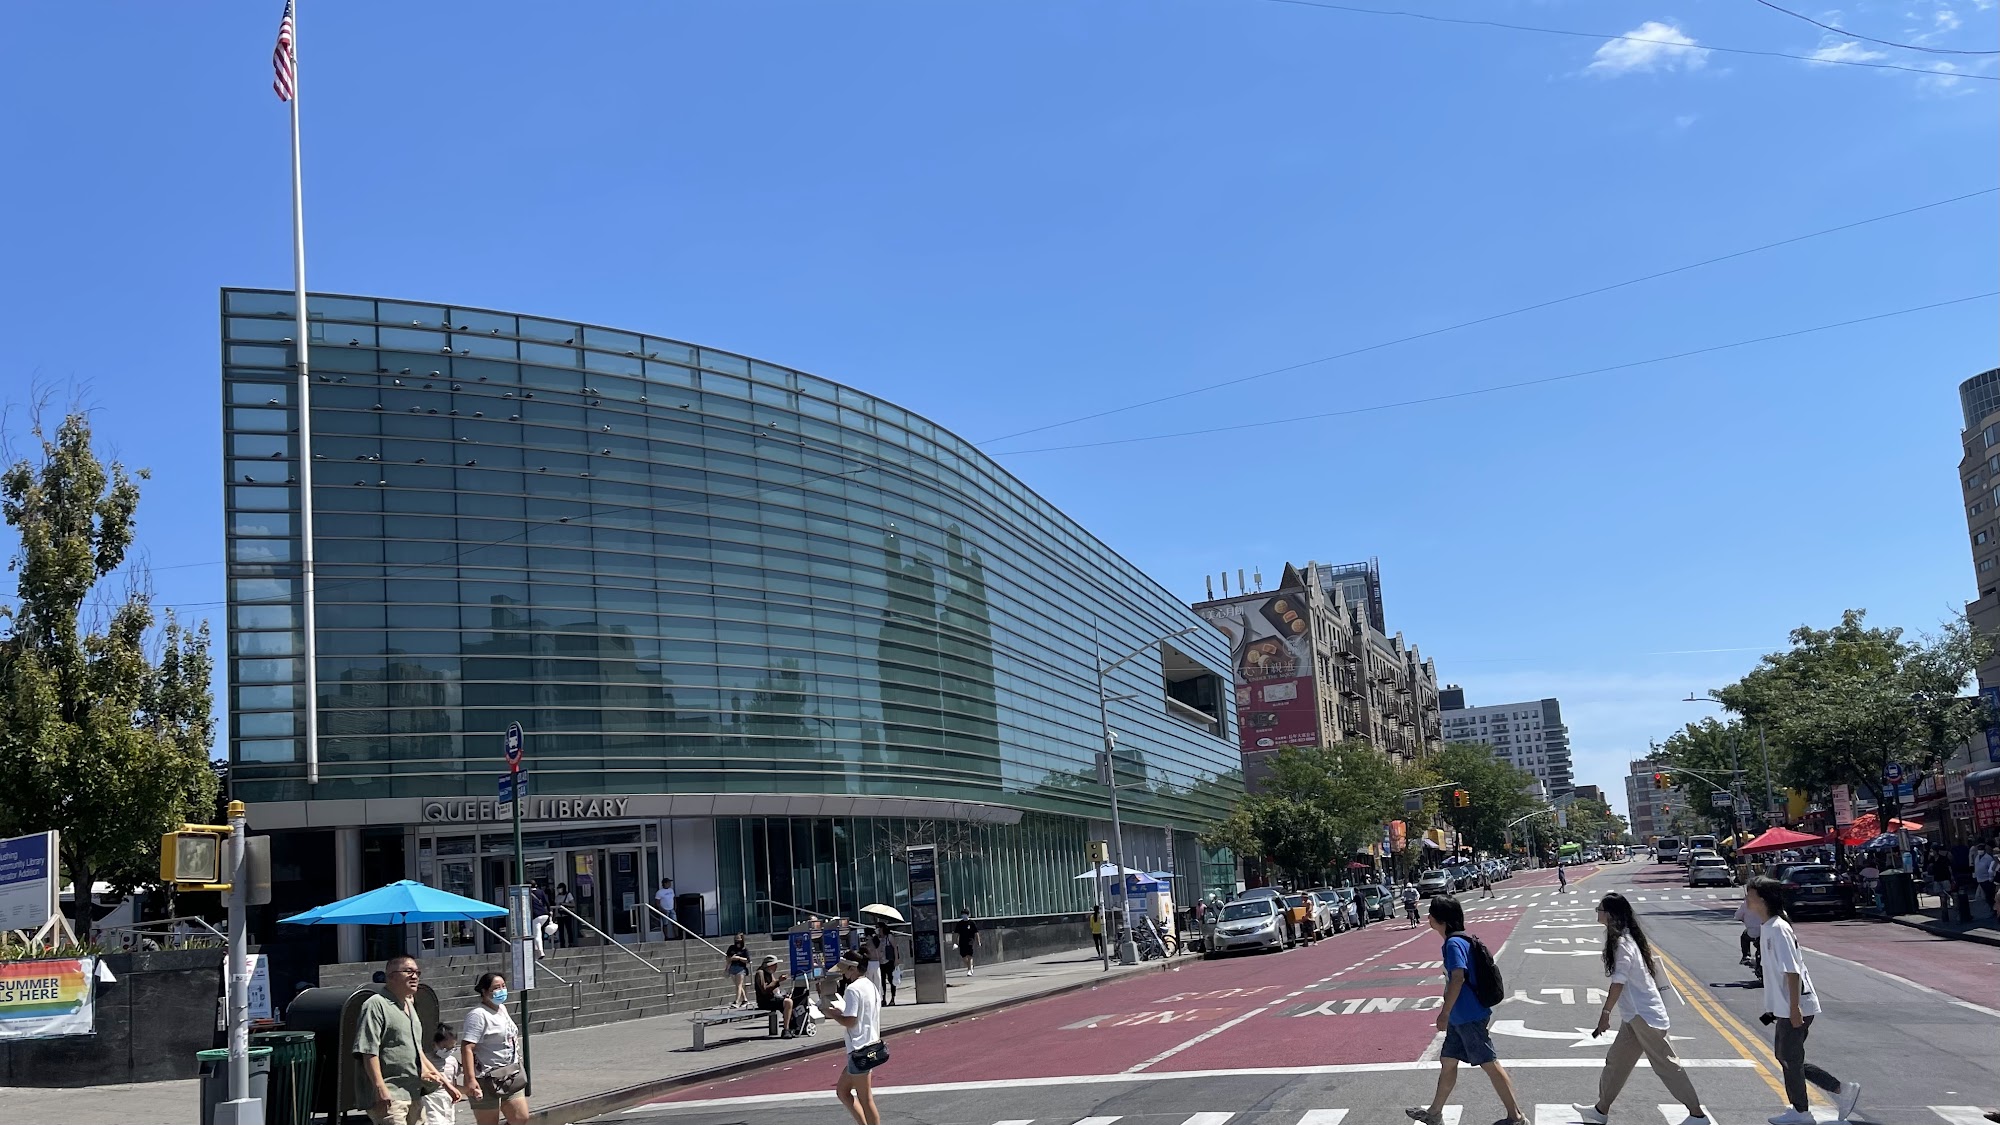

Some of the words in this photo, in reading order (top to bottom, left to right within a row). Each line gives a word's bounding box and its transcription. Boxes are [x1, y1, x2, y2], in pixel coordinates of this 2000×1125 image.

[540, 798, 629, 819] LIBRARY
[20, 988, 58, 1001] HERE
[1502, 987, 1609, 1005] NLY
[1292, 996, 1445, 1018] ONLY
